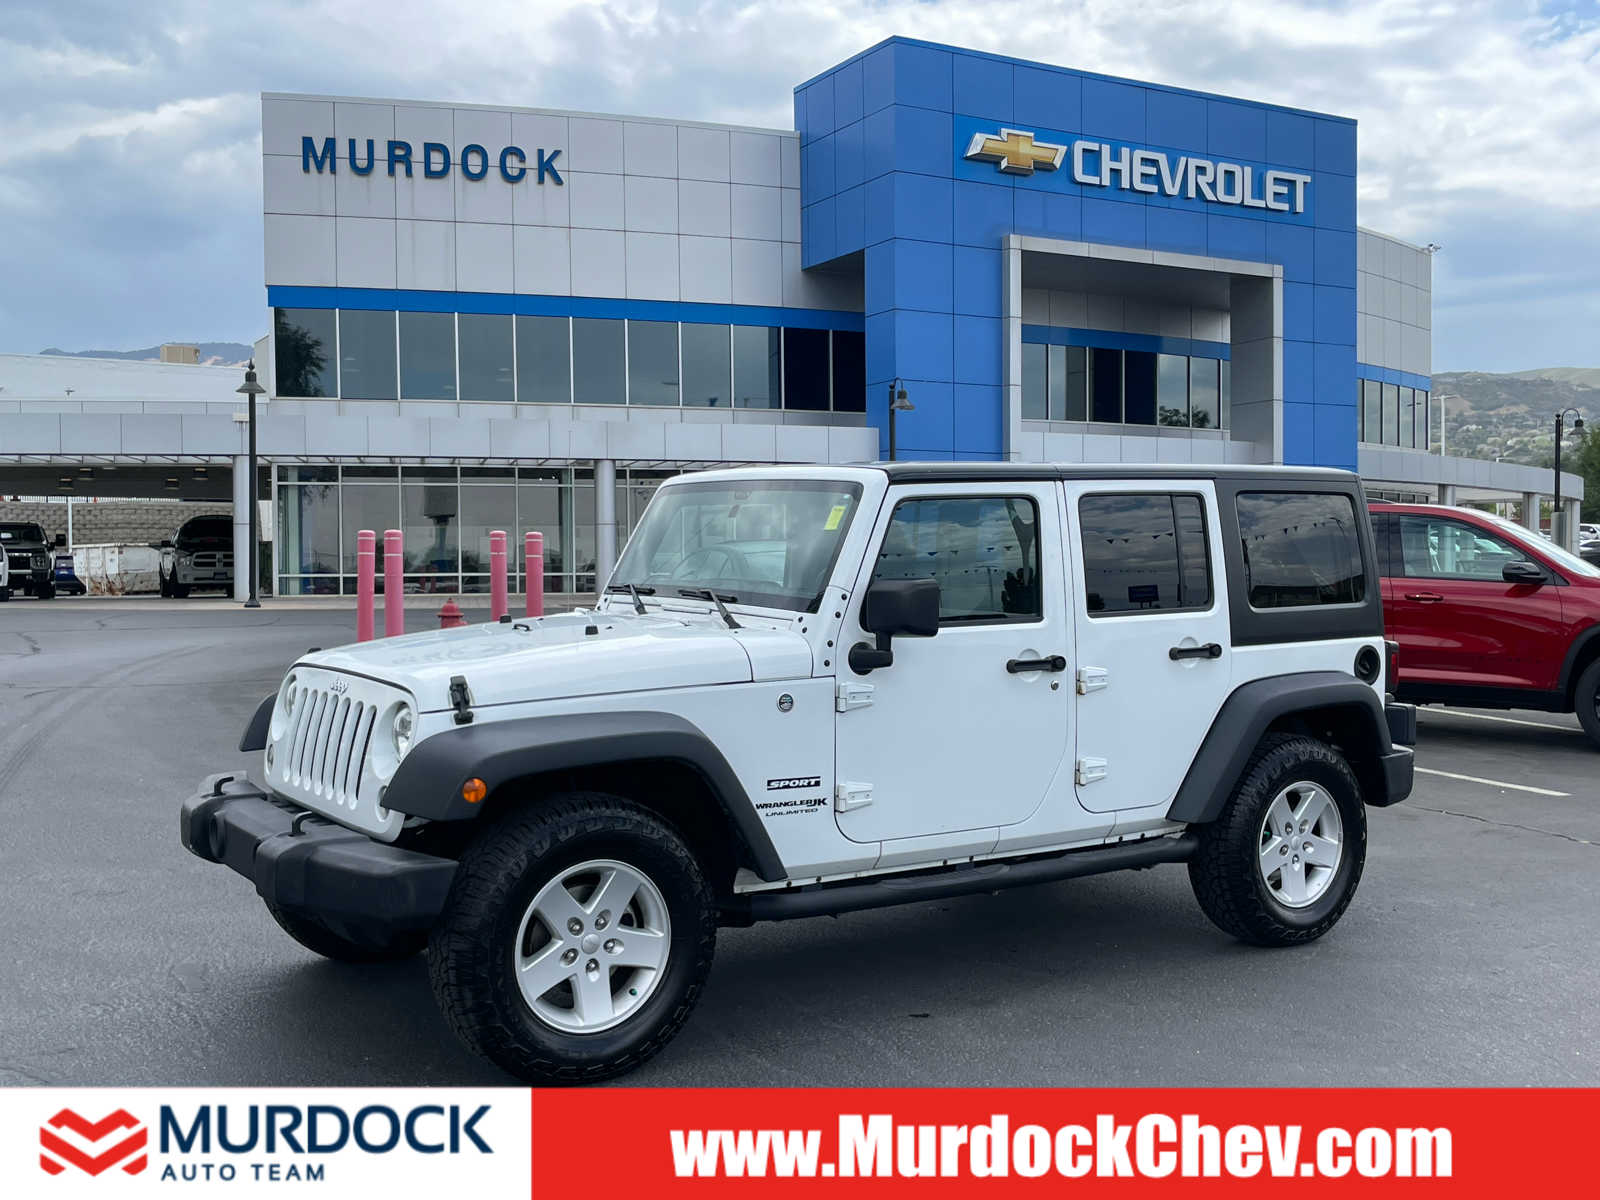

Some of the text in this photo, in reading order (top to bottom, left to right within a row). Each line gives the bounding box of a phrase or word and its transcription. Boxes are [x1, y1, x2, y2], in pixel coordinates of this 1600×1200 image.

[302, 136, 564, 185] MURDOCK
[1073, 140, 1311, 213] CHEVROLET
[769, 779, 820, 788] SPORT
[766, 808, 818, 816] UNLIMITED
